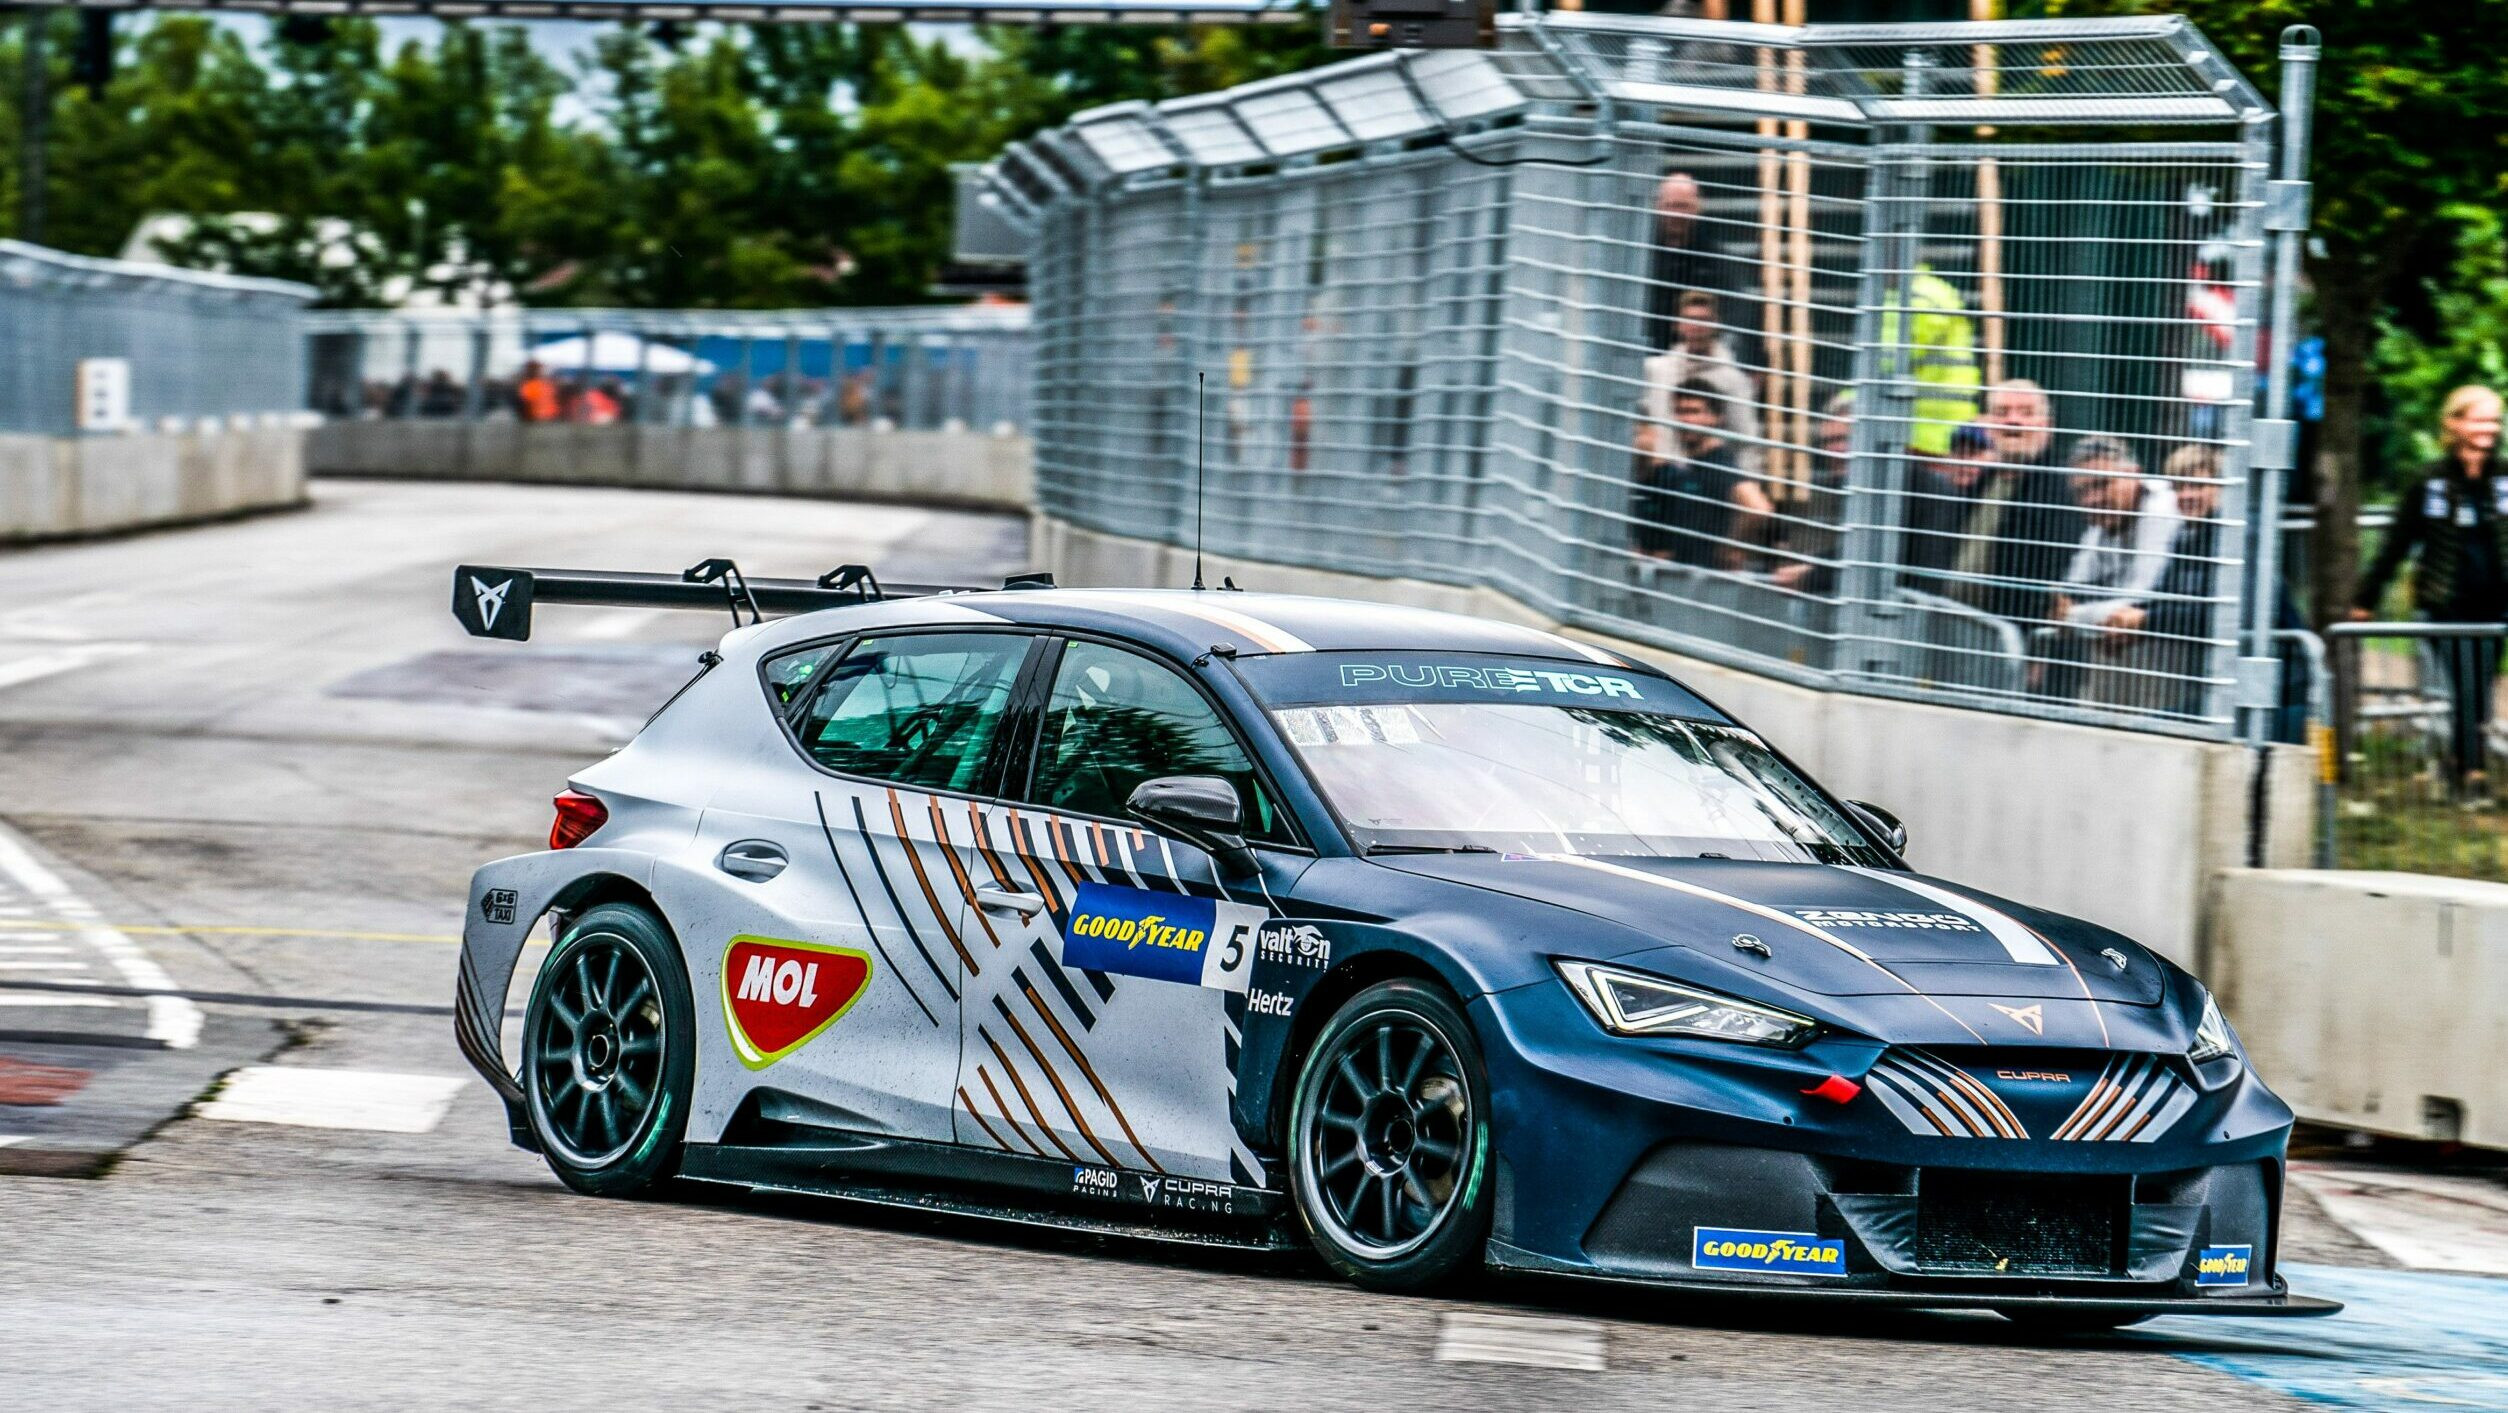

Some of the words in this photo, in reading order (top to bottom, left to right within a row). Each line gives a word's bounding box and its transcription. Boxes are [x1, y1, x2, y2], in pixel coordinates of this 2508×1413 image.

[1811, 920, 1982, 932] MOTORSPORT
[1073, 914, 1205, 952] GOODYEAR
[1219, 924, 1250, 973] 5
[737, 955, 818, 1008] MOL
[1248, 988, 1294, 1016] Hertz
[1997, 1070, 2071, 1083] CUPRA
[1084, 1168, 1118, 1189] PAGID
[1165, 1179, 1232, 1198] CUPRA
[1164, 1195, 1232, 1214] RACNG
[1703, 1239, 1839, 1264] GOODYEAR
